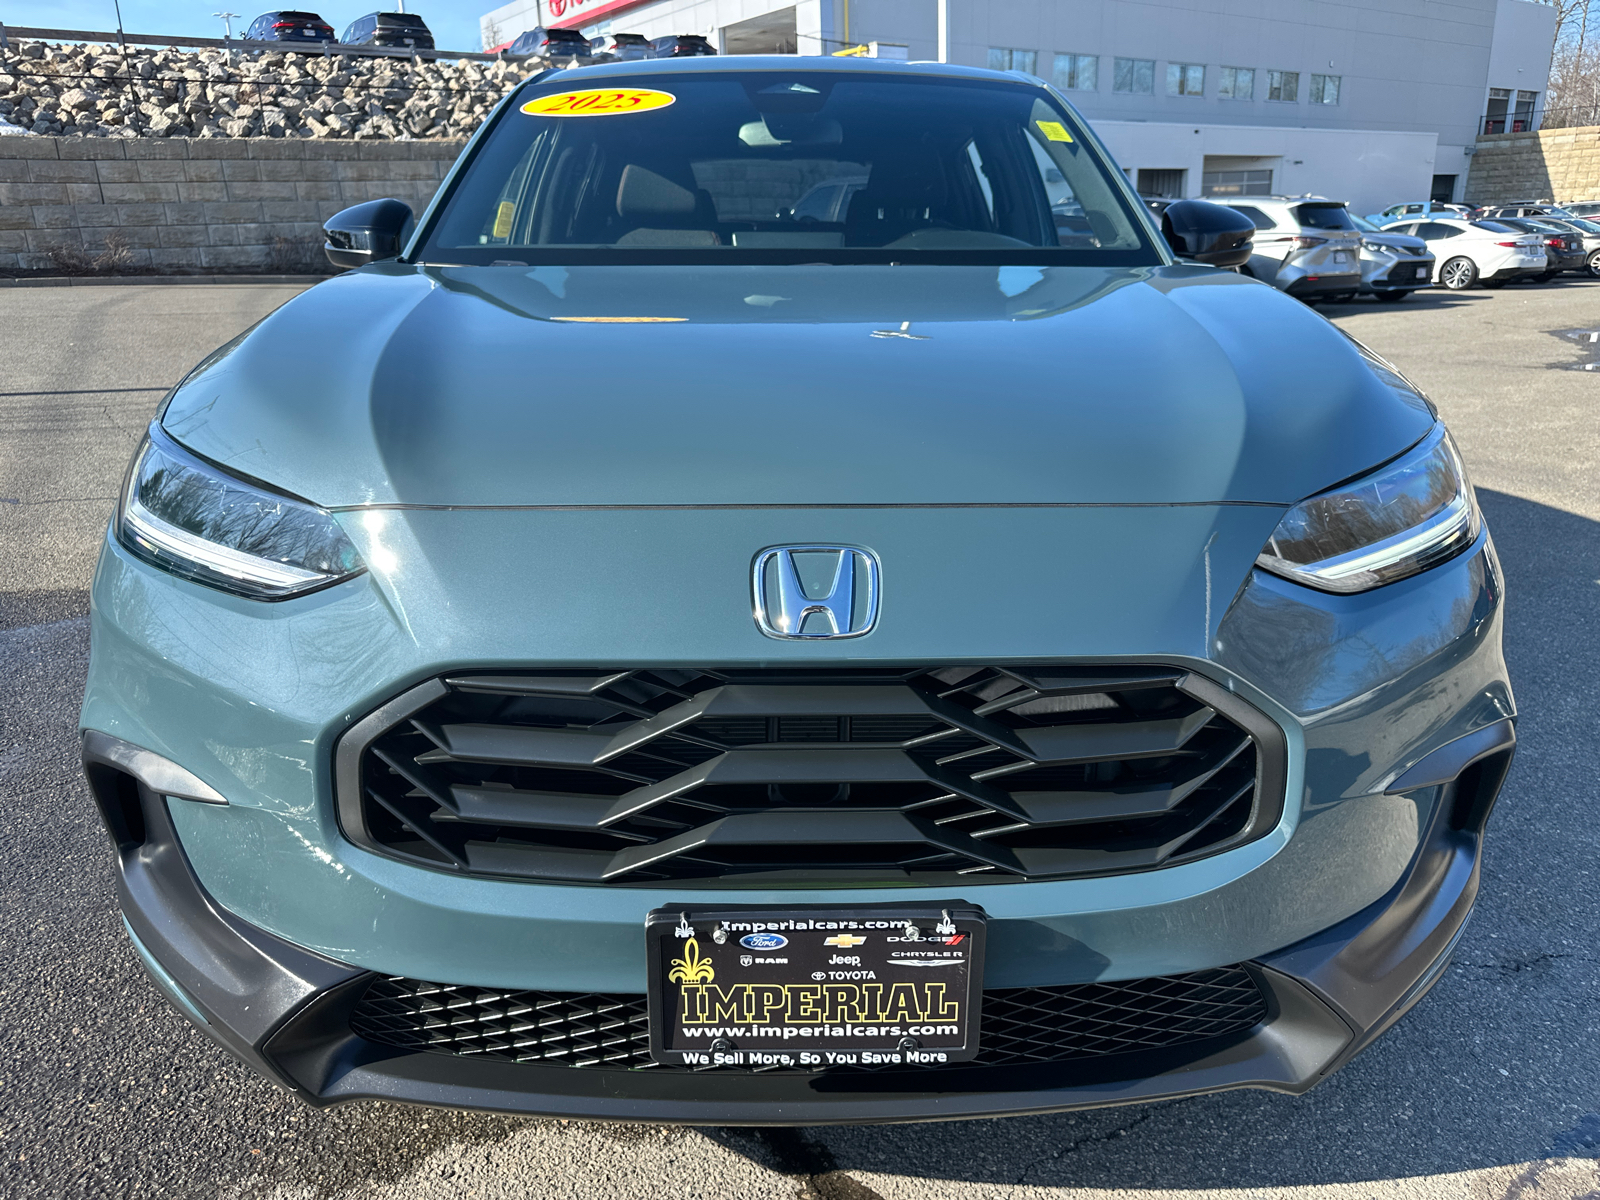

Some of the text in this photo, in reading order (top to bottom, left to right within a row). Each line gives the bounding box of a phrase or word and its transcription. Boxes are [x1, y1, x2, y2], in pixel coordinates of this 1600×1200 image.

[542, 93, 652, 112] 2025
[721, 919, 911, 933] Imperialcars.com
[750, 936, 778, 947] Ford
[754, 957, 789, 965] RAM
[828, 954, 861, 967] Jeep
[828, 971, 877, 981] TOYOTA
[681, 982, 959, 1024] IMPERIAL
[682, 1024, 959, 1040] www.imperialcars.com
[682, 1050, 948, 1067] We Sell More, So You Save More
